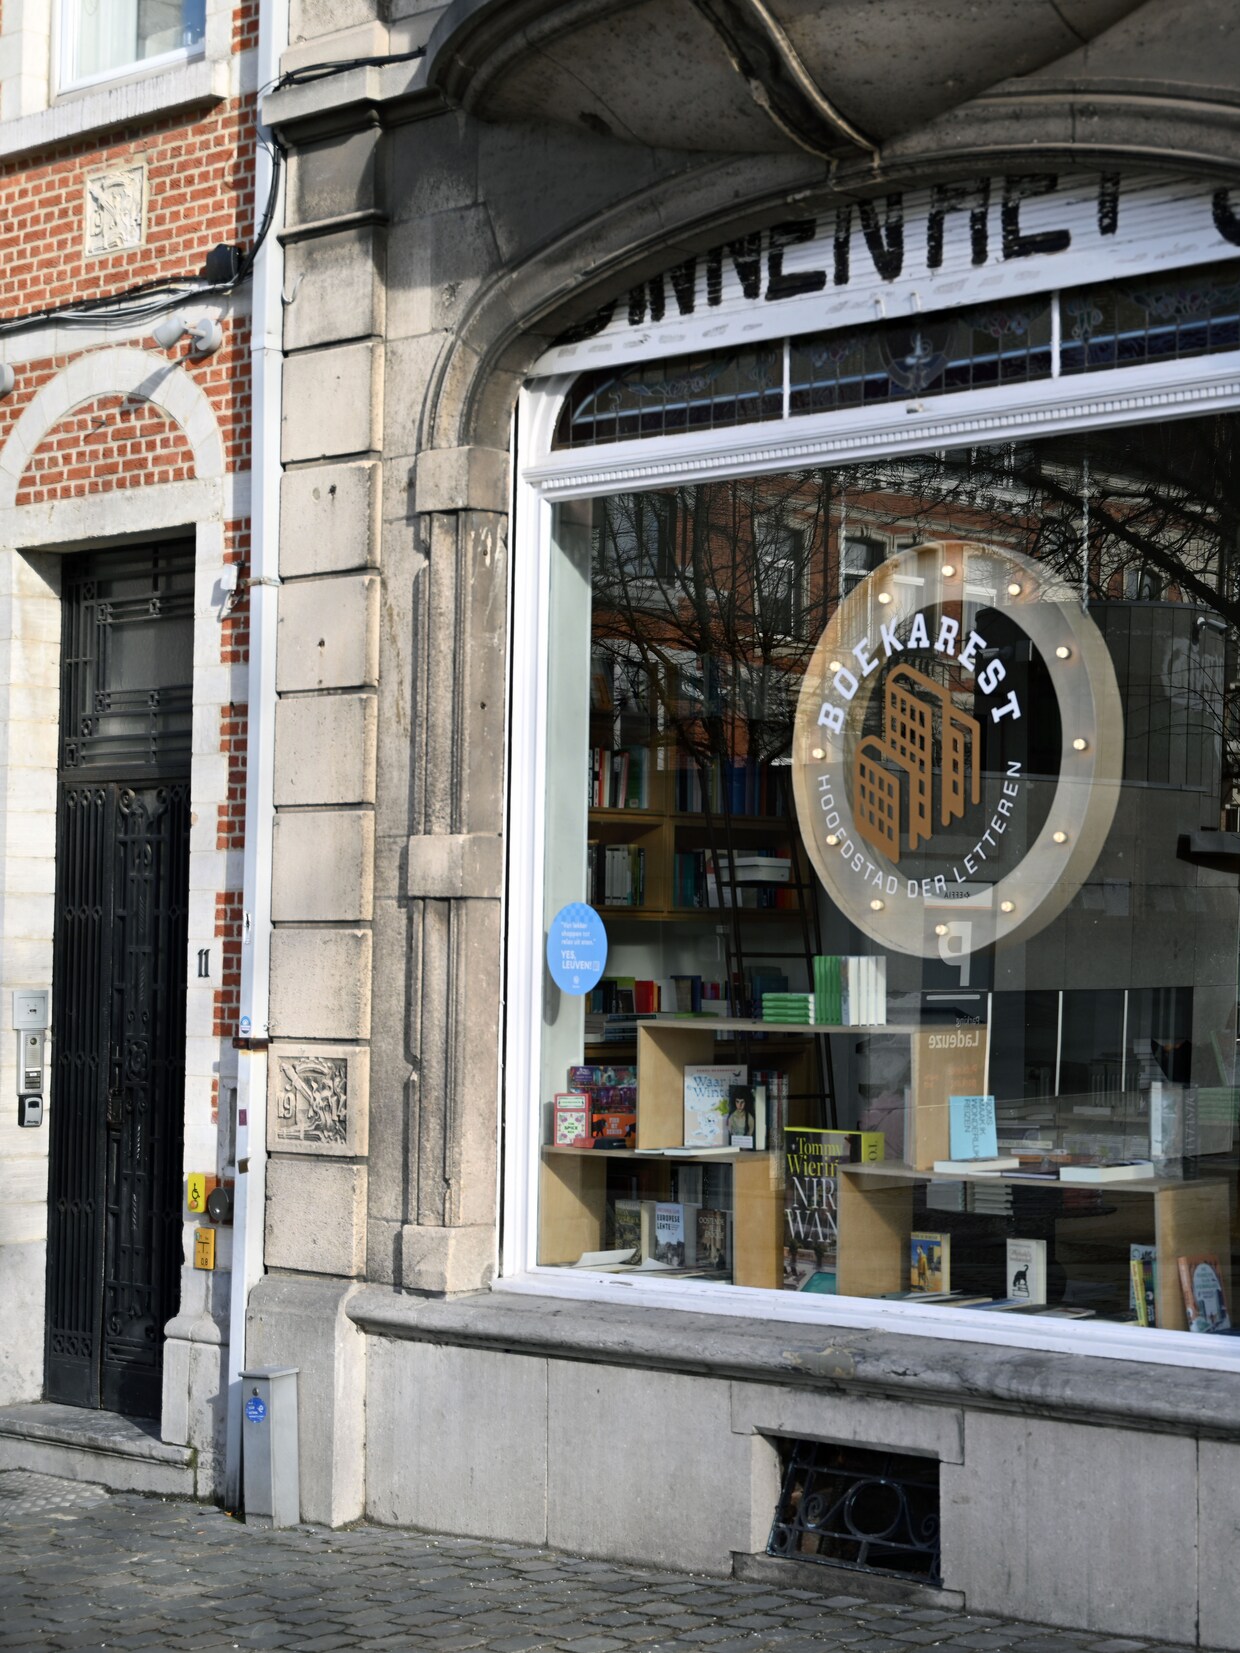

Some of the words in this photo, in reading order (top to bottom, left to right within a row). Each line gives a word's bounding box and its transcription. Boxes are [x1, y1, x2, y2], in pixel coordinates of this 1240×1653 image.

[817, 612, 1022, 734] BOEKAREST
[818, 774, 898, 895] HOOFDSTAD
[907, 874, 947, 898] DER
[952, 761, 1022, 884] LETTEREN
[197, 948, 211, 978] 11
[562, 960, 593, 970] LEUVEN!
[693, 1075, 726, 1087] Waar
[796, 1137, 844, 1156] Tommy
[792, 1176, 837, 1210] NIR
[656, 1214, 681, 1223] EUROPESE
[656, 1222, 671, 1231] LENTE
